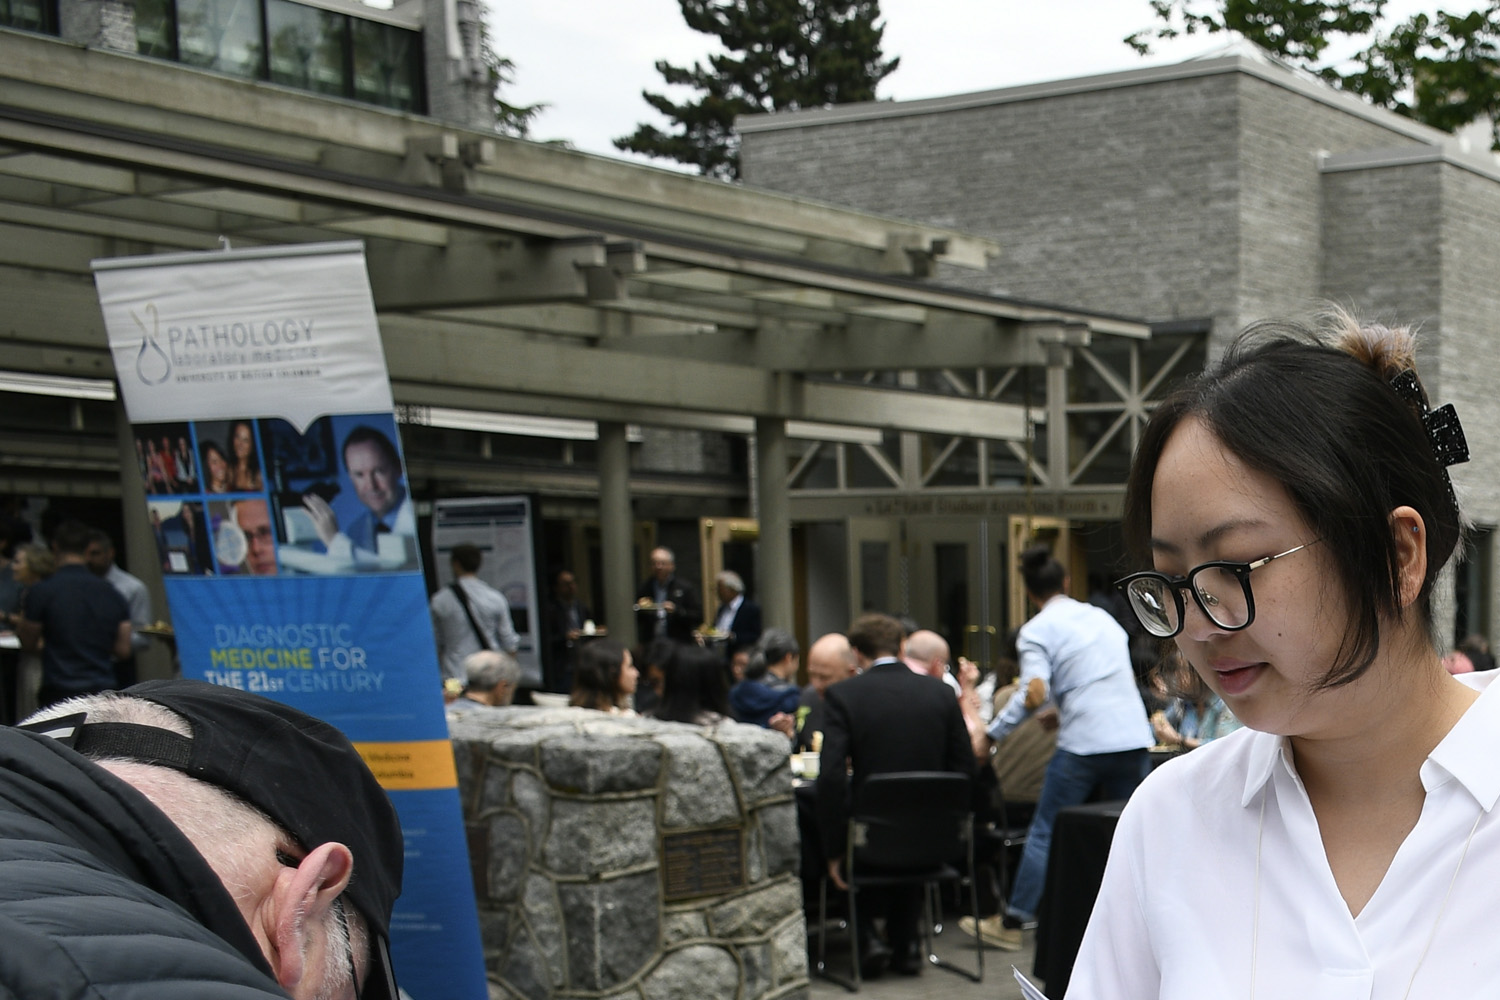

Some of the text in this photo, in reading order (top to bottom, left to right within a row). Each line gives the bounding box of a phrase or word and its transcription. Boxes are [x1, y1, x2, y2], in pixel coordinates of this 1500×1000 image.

[168, 318, 315, 349] PATHOLOGY
[213, 623, 355, 648] DIAGNOSTIC
[210, 647, 369, 671] MEDICINE FOR
[203, 670, 246, 692] THE
[286, 670, 386, 693] CENTURY
